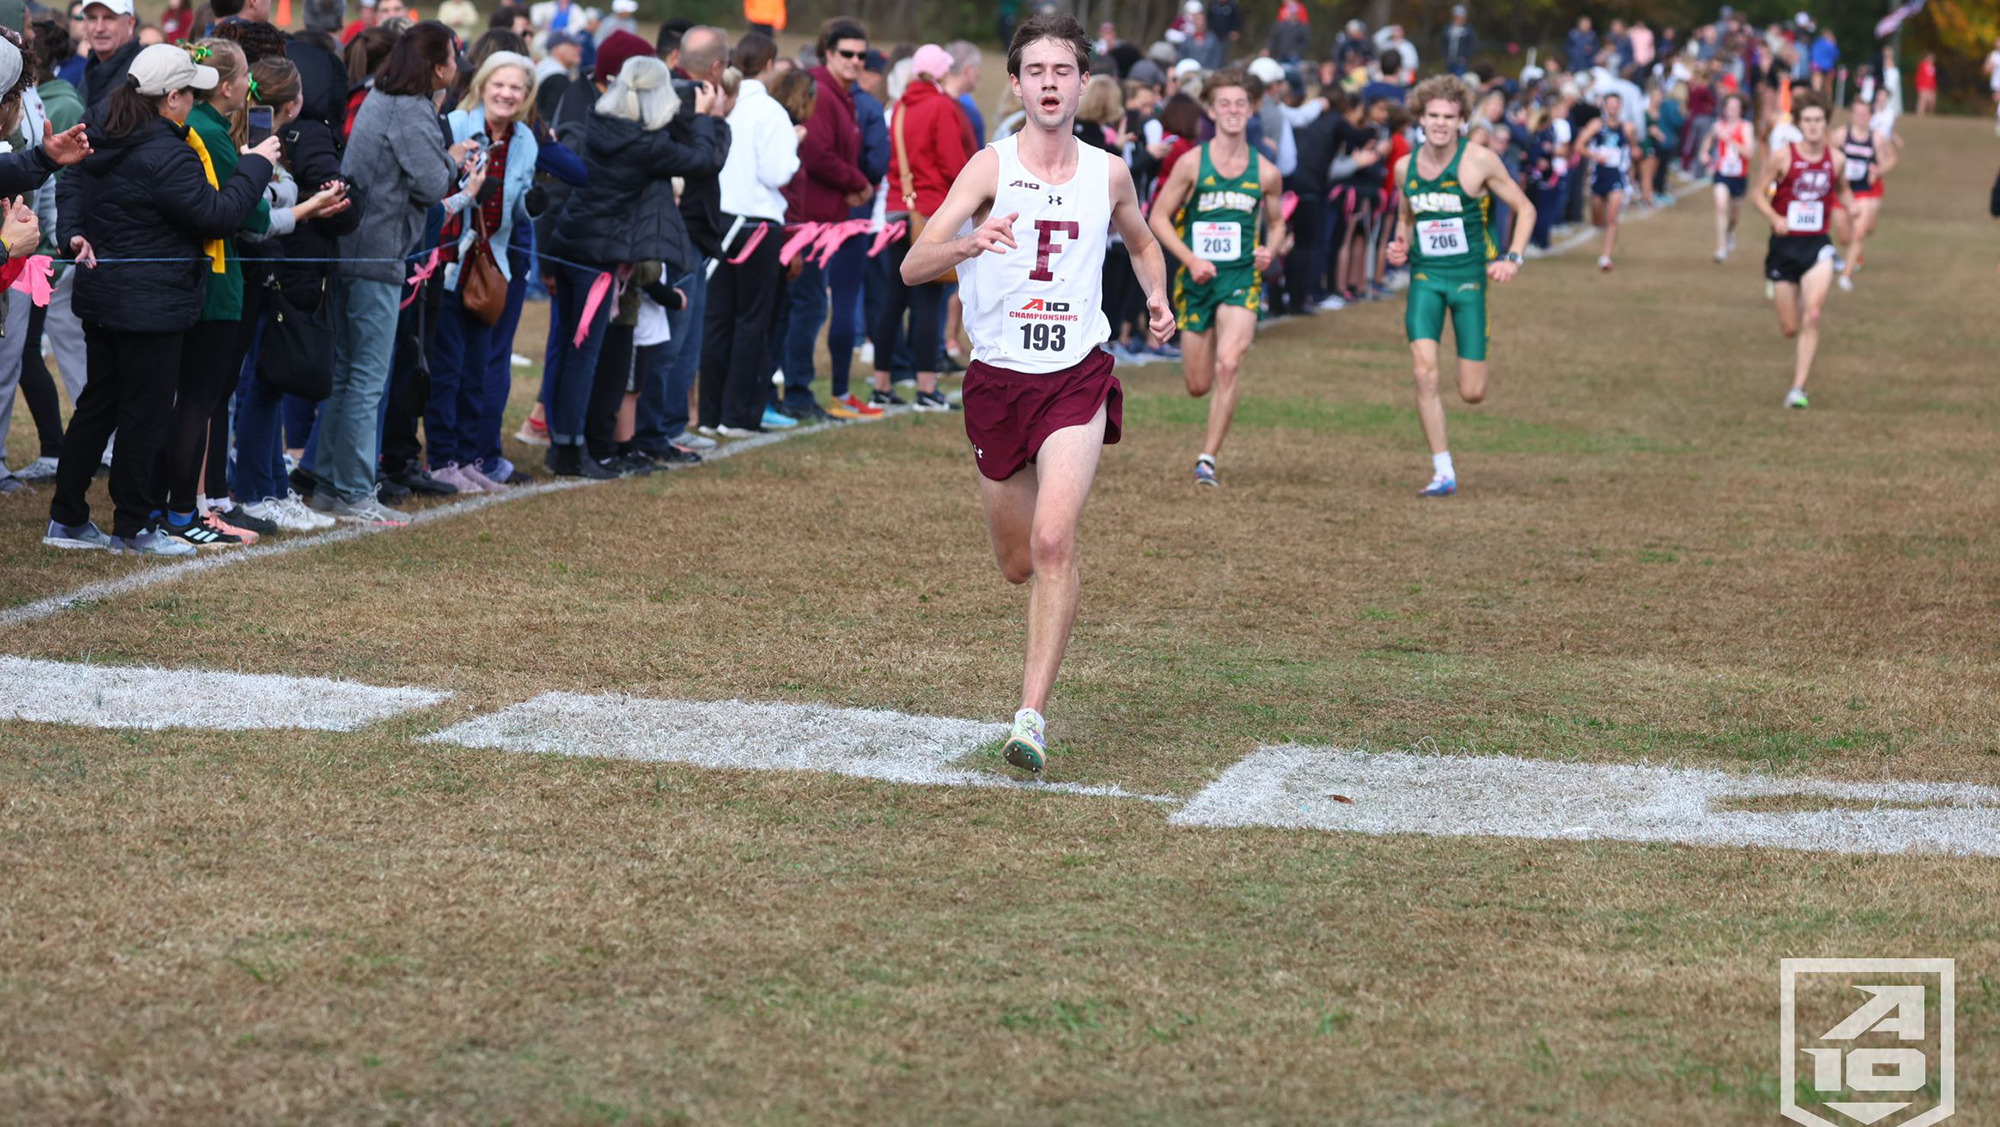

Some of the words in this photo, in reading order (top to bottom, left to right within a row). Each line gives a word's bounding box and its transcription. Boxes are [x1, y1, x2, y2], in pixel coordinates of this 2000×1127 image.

[1009, 180, 1040, 190] A10
[1203, 238, 1232, 253] 203
[1429, 233, 1458, 249] 206
[1029, 220, 1080, 282] F
[1009, 301, 1079, 322] CHAMPIONSHIPS
[1021, 298, 1070, 312] A10
[1020, 322, 1067, 352] 193
